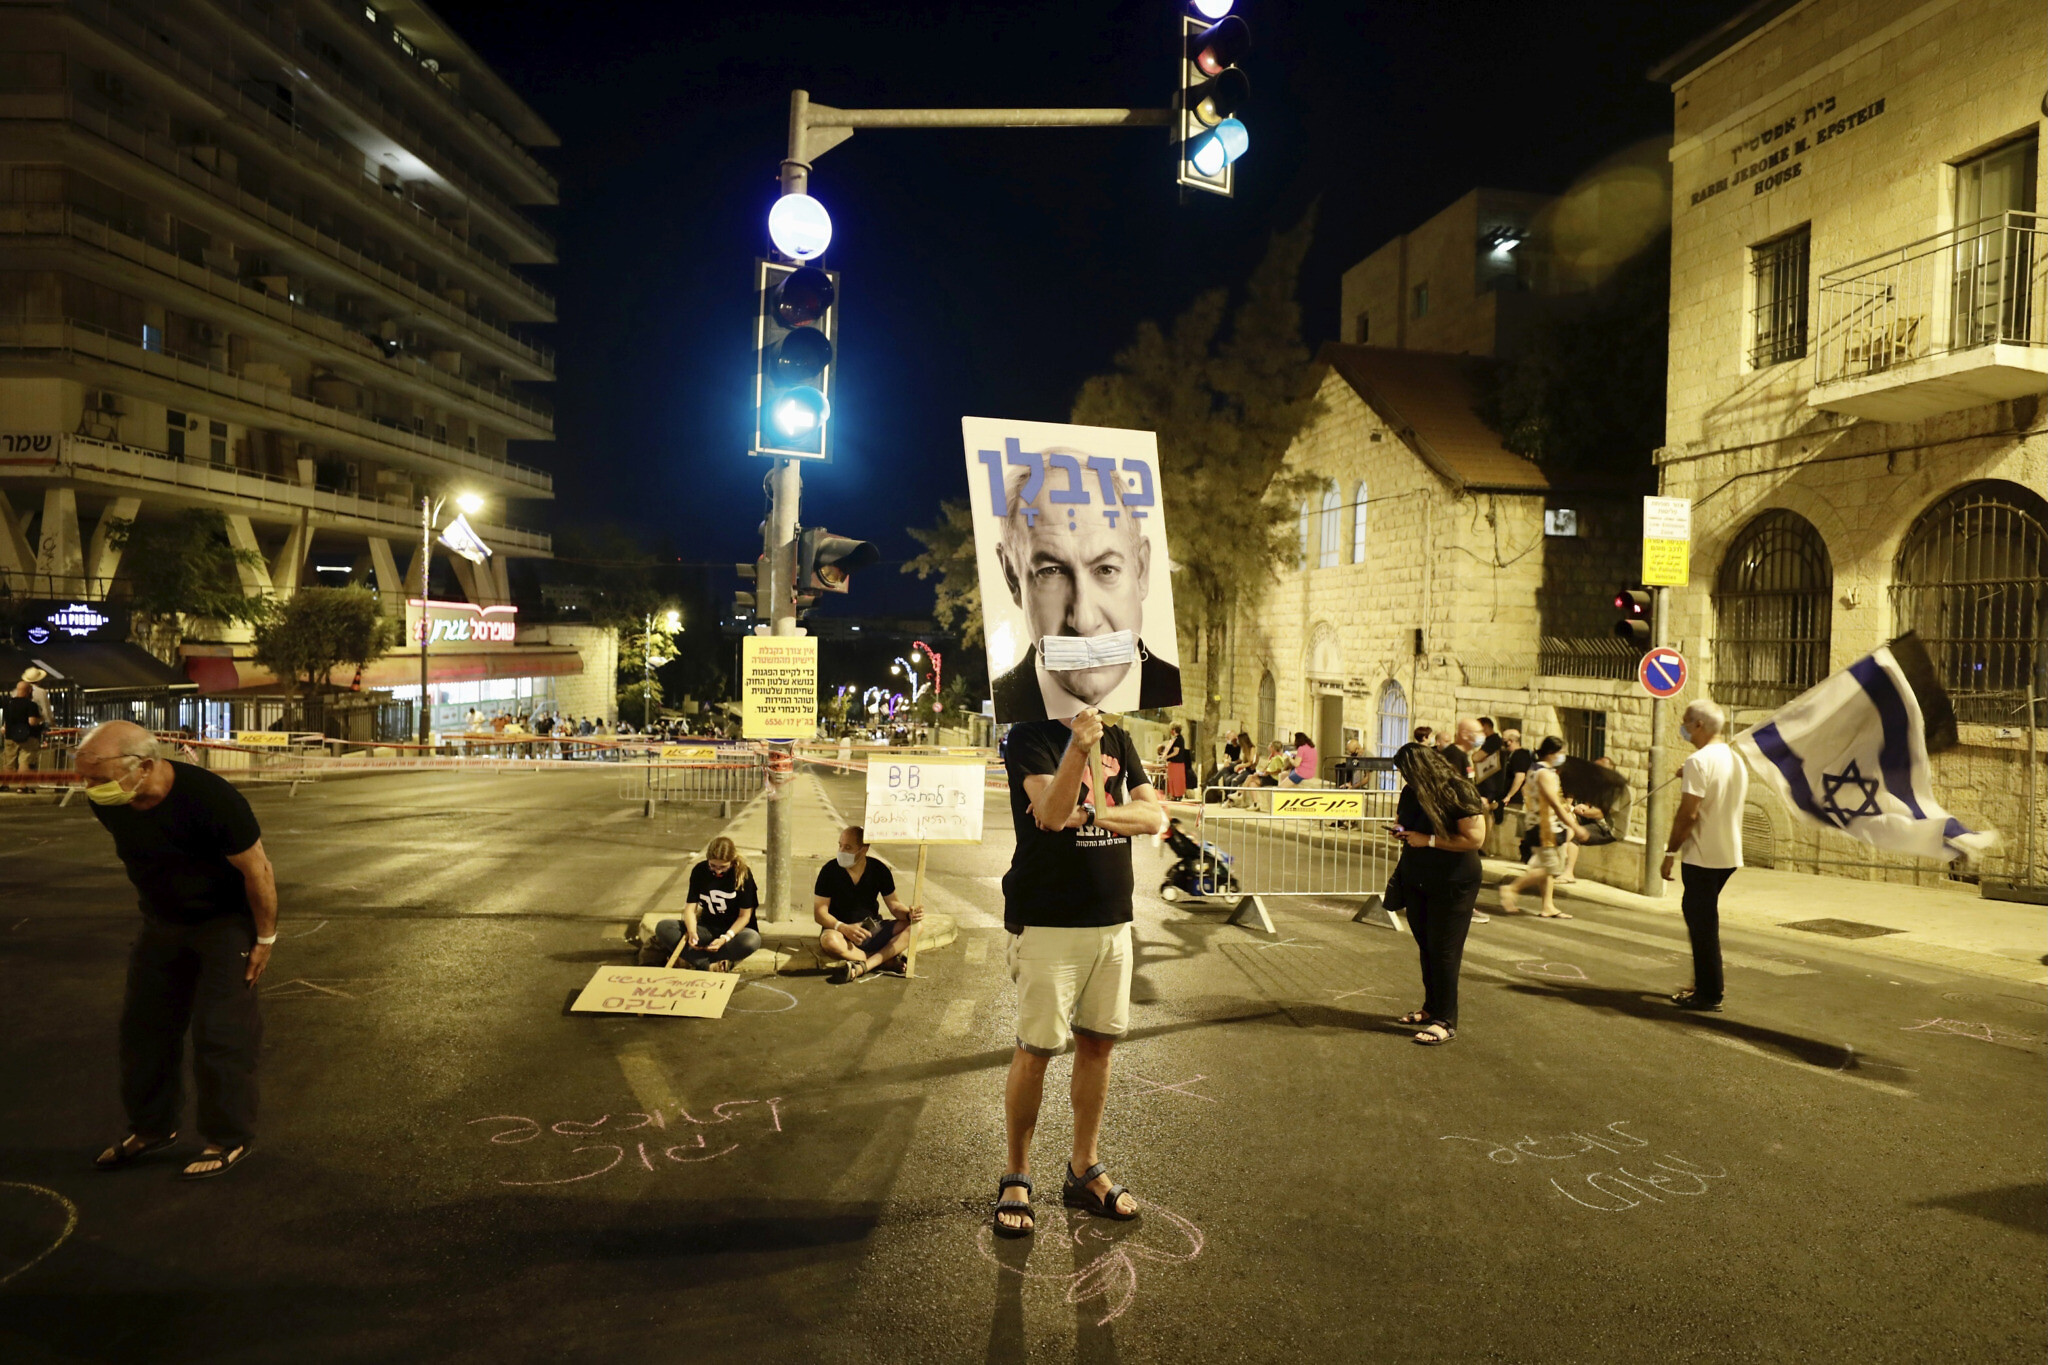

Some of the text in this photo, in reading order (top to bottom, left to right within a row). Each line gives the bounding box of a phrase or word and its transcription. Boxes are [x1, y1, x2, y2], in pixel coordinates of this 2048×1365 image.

[1803, 96, 1837, 126] בית
[1691, 98, 1886, 206] RABBI JEROME M. EPSTEIN
[1754, 162, 1802, 196] HOUSE
[55, 613, 67, 625] LA
[470, 617, 516, 641] שופרסל
[803, 647, 815, 656] אין
[780, 668, 801, 678] לקיים
[767, 678, 790, 687] שלטון
[751, 687, 783, 695] שלטונית
[802, 705, 814, 713] של
